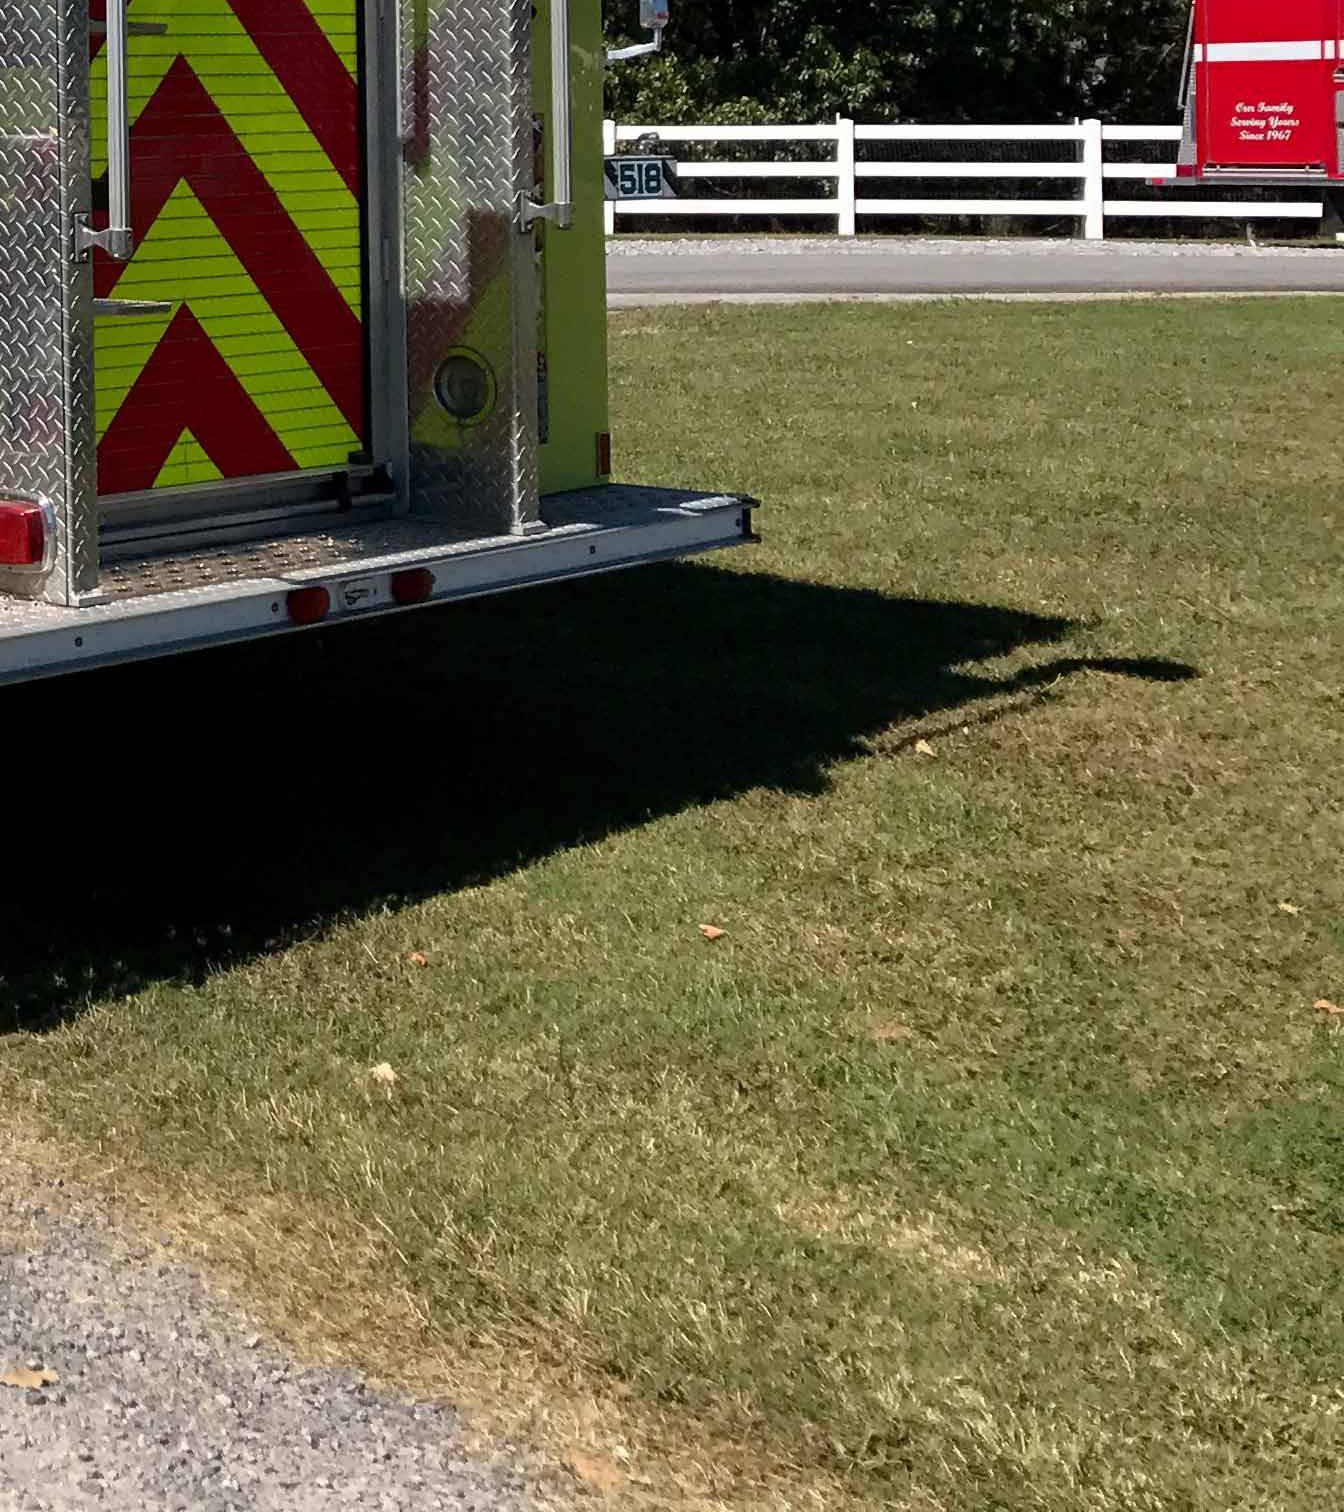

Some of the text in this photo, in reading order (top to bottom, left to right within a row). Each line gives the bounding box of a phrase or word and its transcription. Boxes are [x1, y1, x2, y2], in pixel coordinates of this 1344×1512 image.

[1235, 101, 1294, 115] Our Family
[1230, 115, 1300, 129] Serving Yours
[1238, 129, 1292, 141] Since 1967
